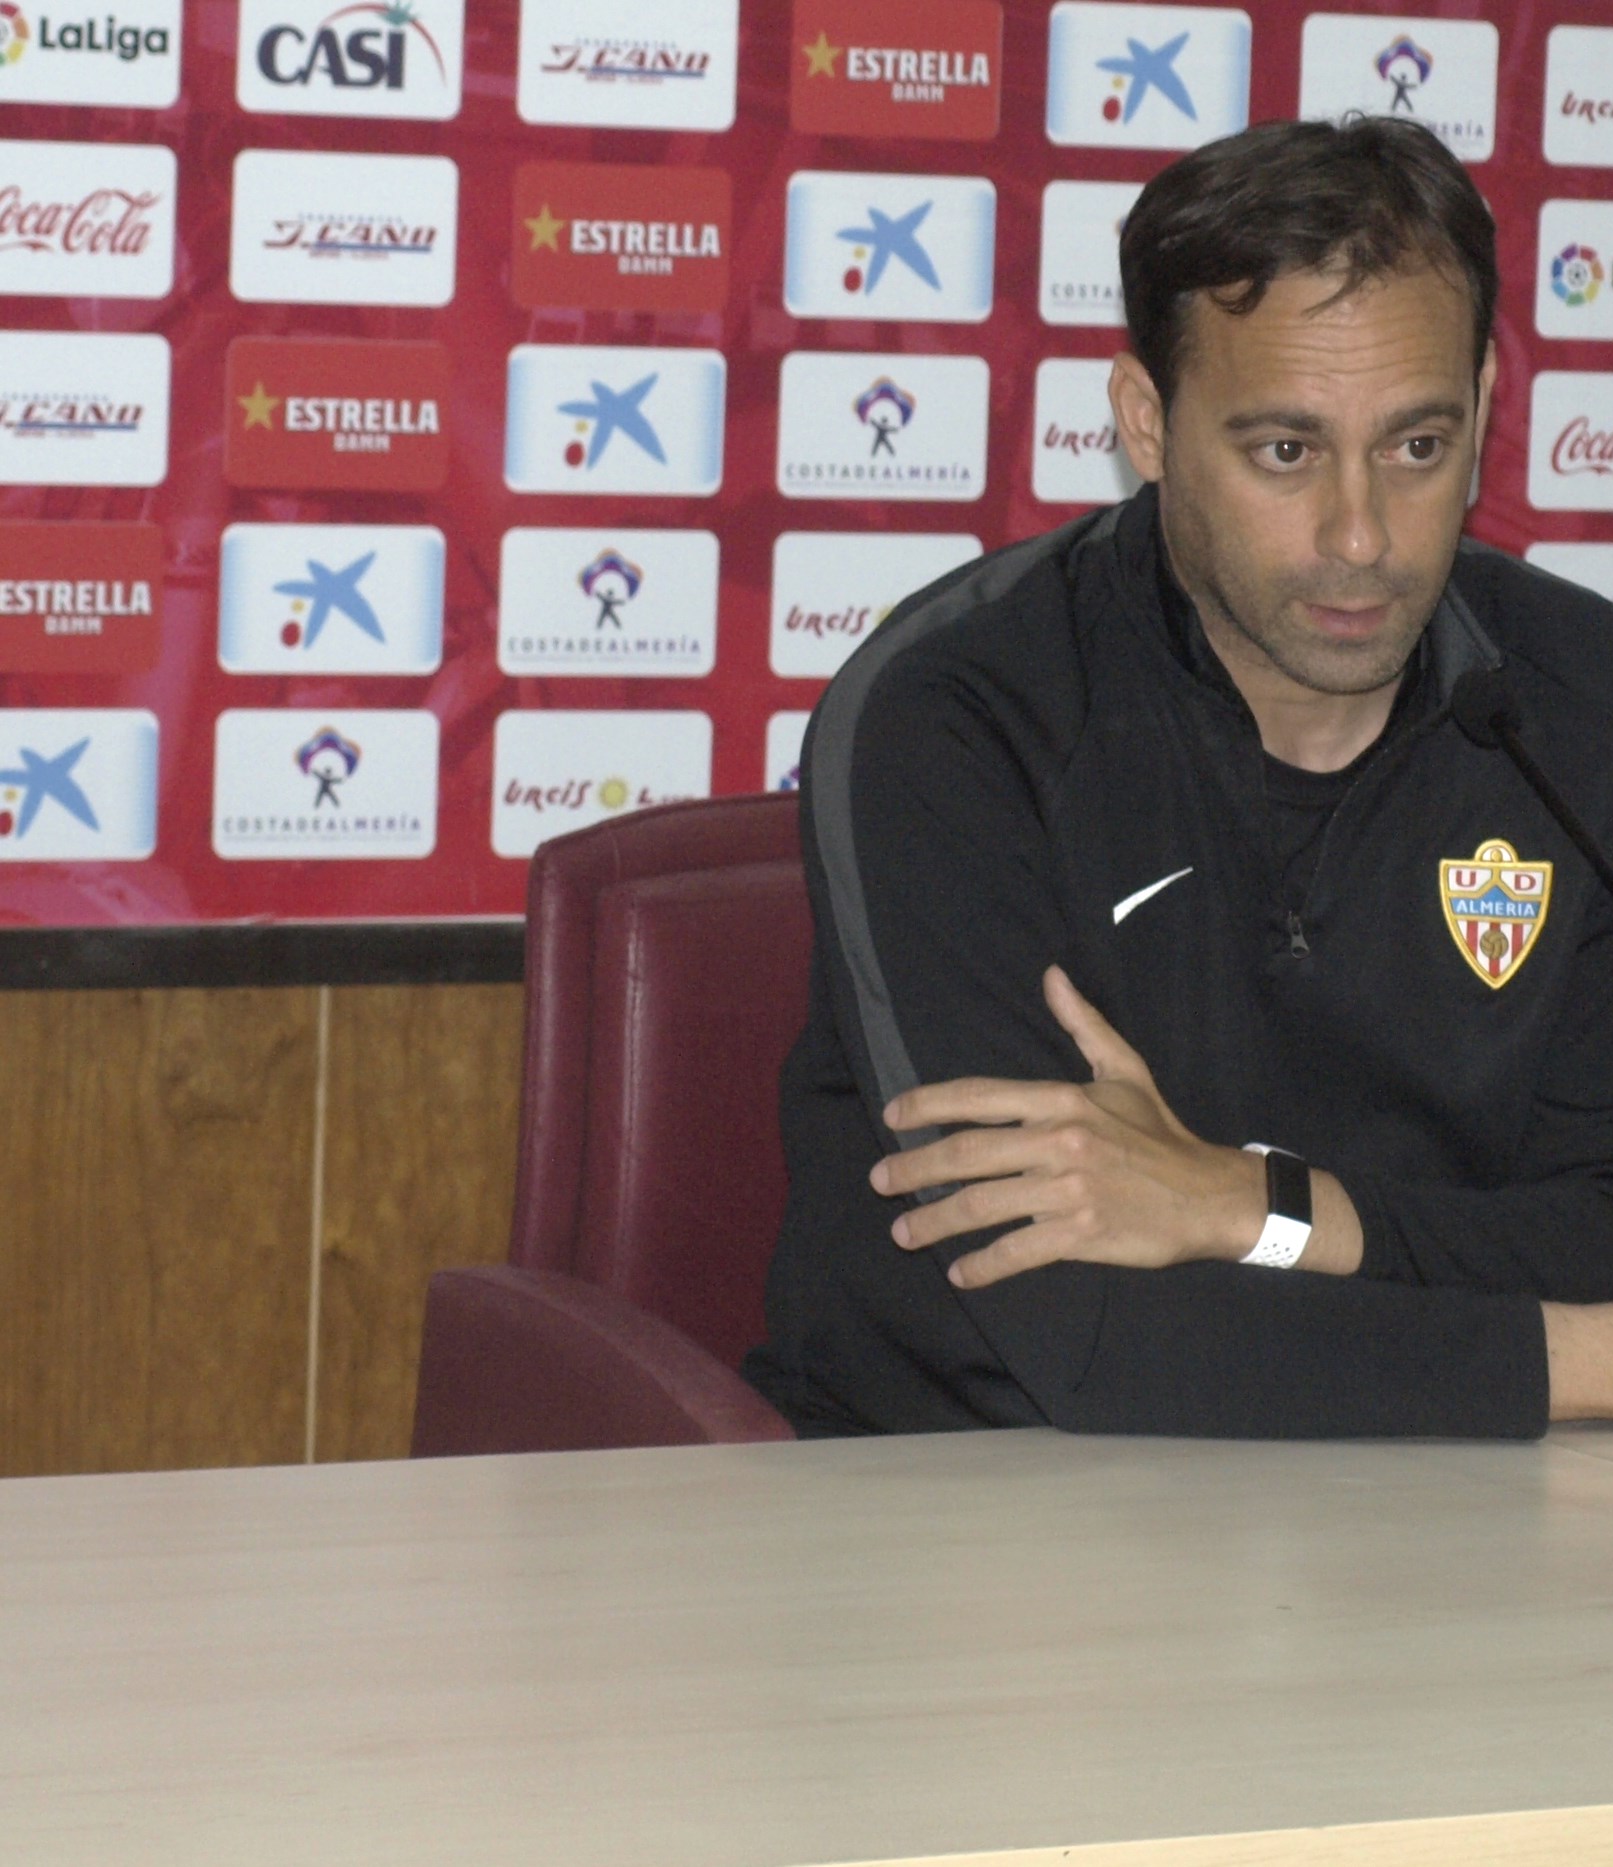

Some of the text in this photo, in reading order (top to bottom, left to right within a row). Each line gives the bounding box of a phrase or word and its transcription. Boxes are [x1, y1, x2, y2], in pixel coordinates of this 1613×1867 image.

[38, 16, 170, 61] LaLiga
[257, 24, 407, 91] CASI
[846, 47, 990, 87] ESTRELLA
[891, 82, 945, 102] DAMM
[571, 219, 721, 257] ESTRELLA
[617, 255, 673, 276] DAMM
[285, 396, 439, 434] ESTRELLA
[334, 432, 391, 452] DAMM
[0, 580, 151, 615] ESTRELLA
[44, 616, 102, 635] DAMM
[1455, 870, 1537, 891] U D
[1456, 899, 1536, 917] ALMERIA
